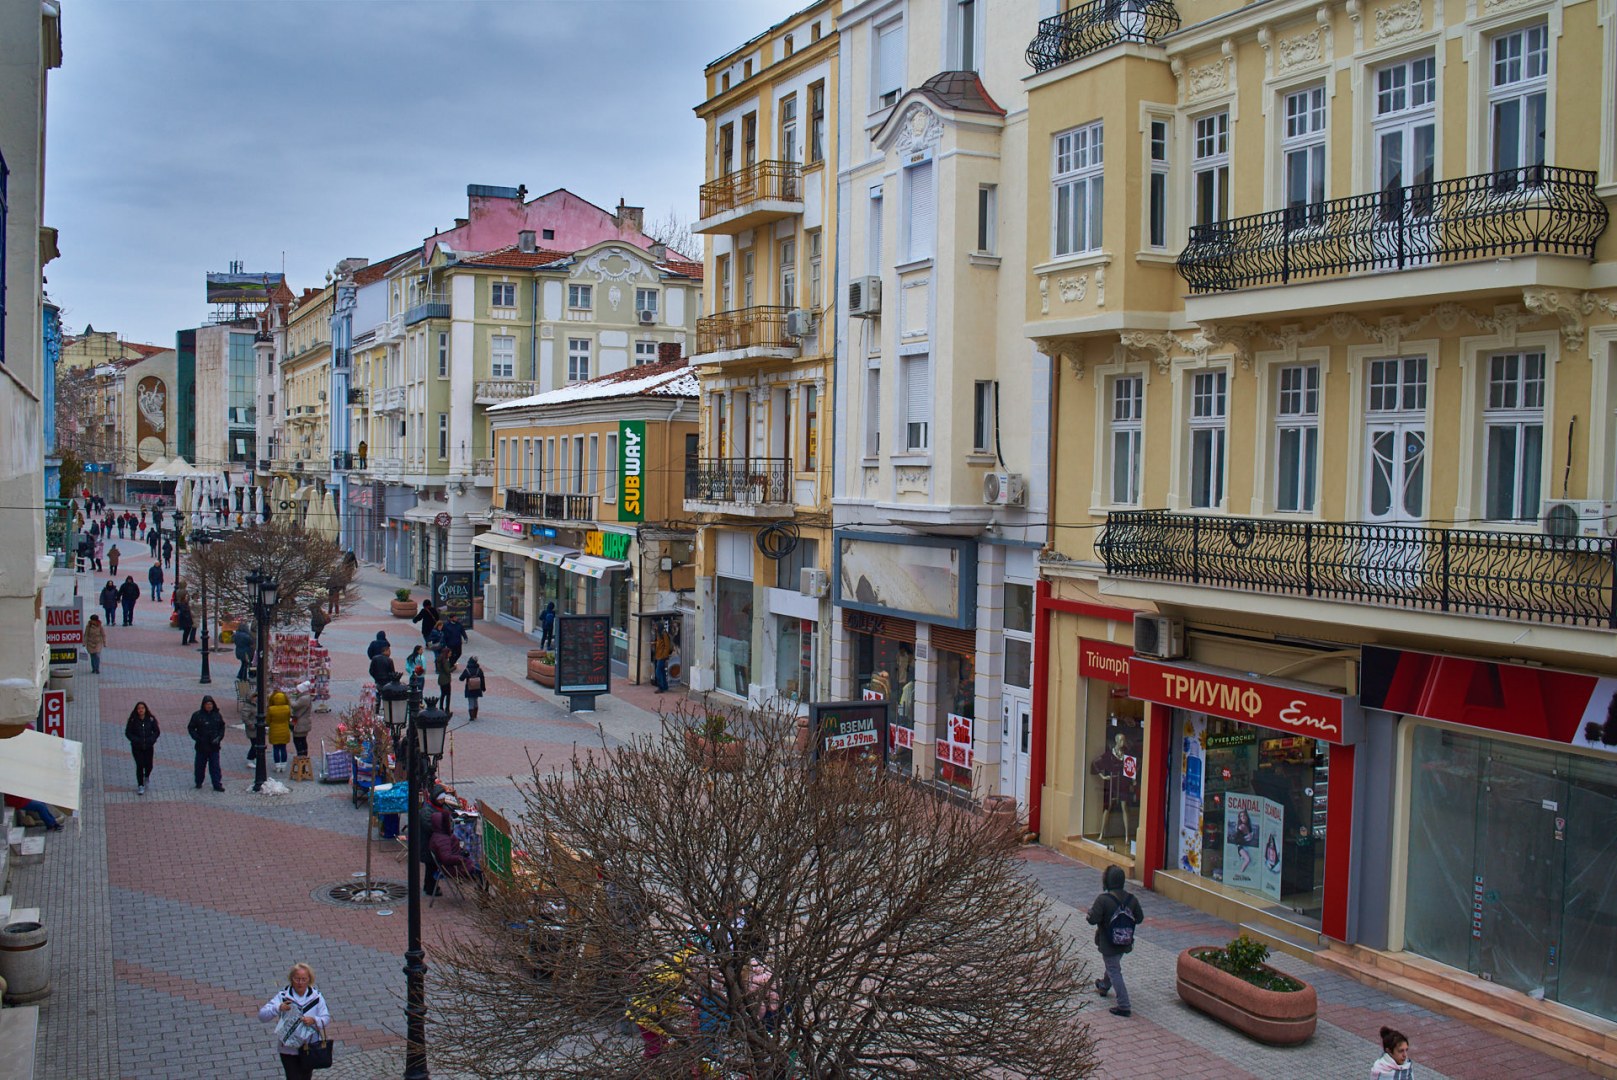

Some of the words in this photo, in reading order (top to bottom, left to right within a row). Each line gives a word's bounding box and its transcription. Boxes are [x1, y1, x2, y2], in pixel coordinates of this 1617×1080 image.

[625, 427, 640, 515] SUBWAY
[585, 530, 631, 560] SUBWAY
[1086, 651, 1129, 677] Triumph
[1162, 672, 1262, 718] ТРИУМФ
[840, 717, 874, 734] ВЗЕМИ
[1228, 797, 1260, 812] SCANDAL
[1265, 803, 1281, 821] SCANDAL
